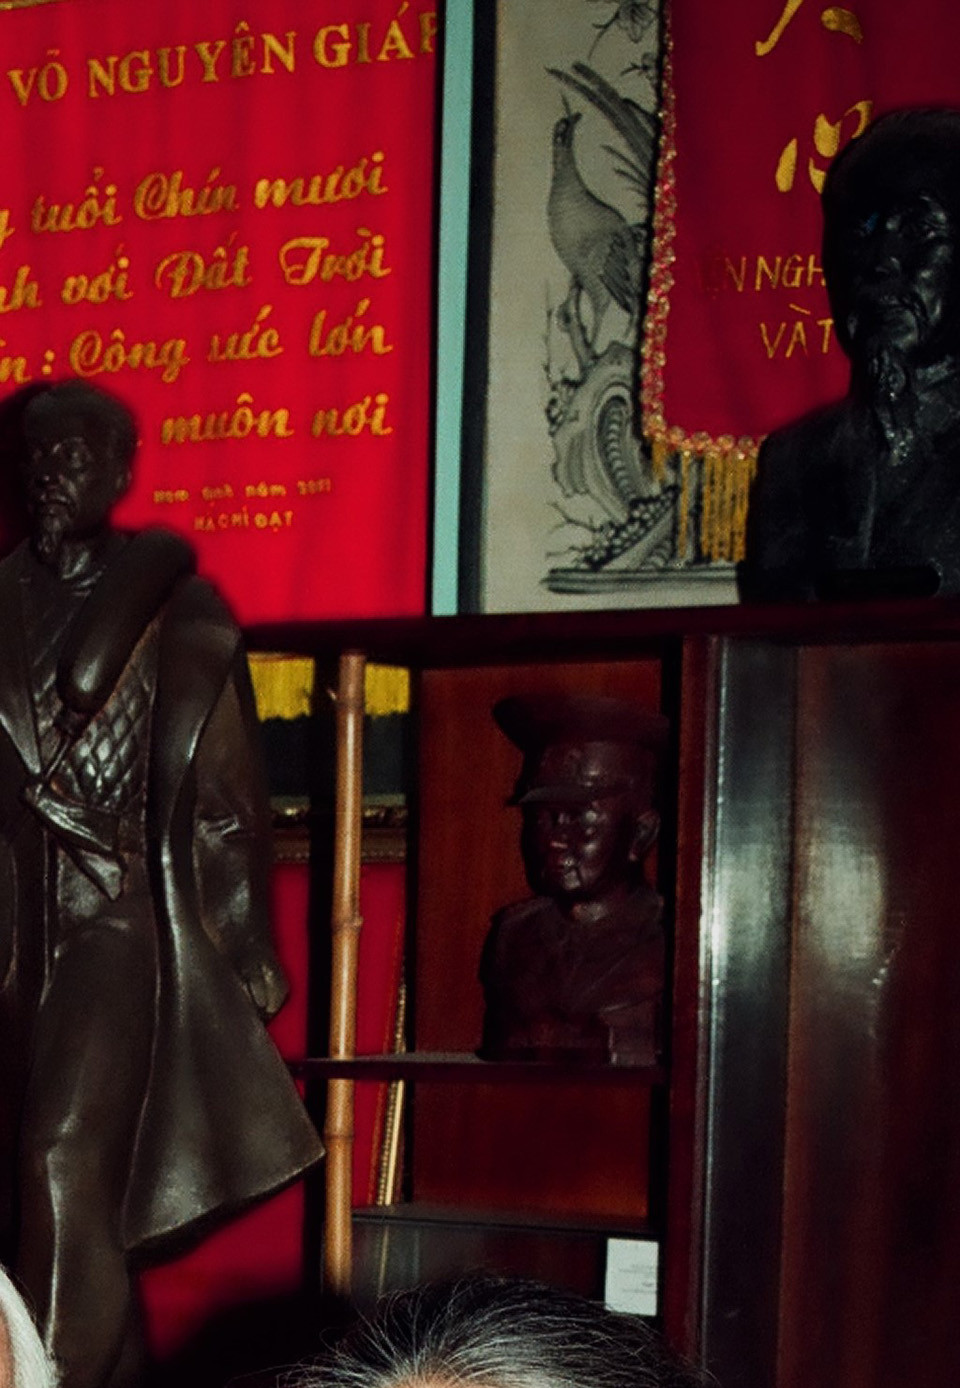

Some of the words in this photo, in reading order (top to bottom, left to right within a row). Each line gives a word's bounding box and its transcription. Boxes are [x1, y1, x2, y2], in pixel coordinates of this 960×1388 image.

[7, 49, 68, 107] VÕ
[87, 21, 297, 98] NGUYÊN
[69, 329, 190, 382] Công
[309, 298, 393, 357] lớn
[161, 393, 293, 445] muôn
